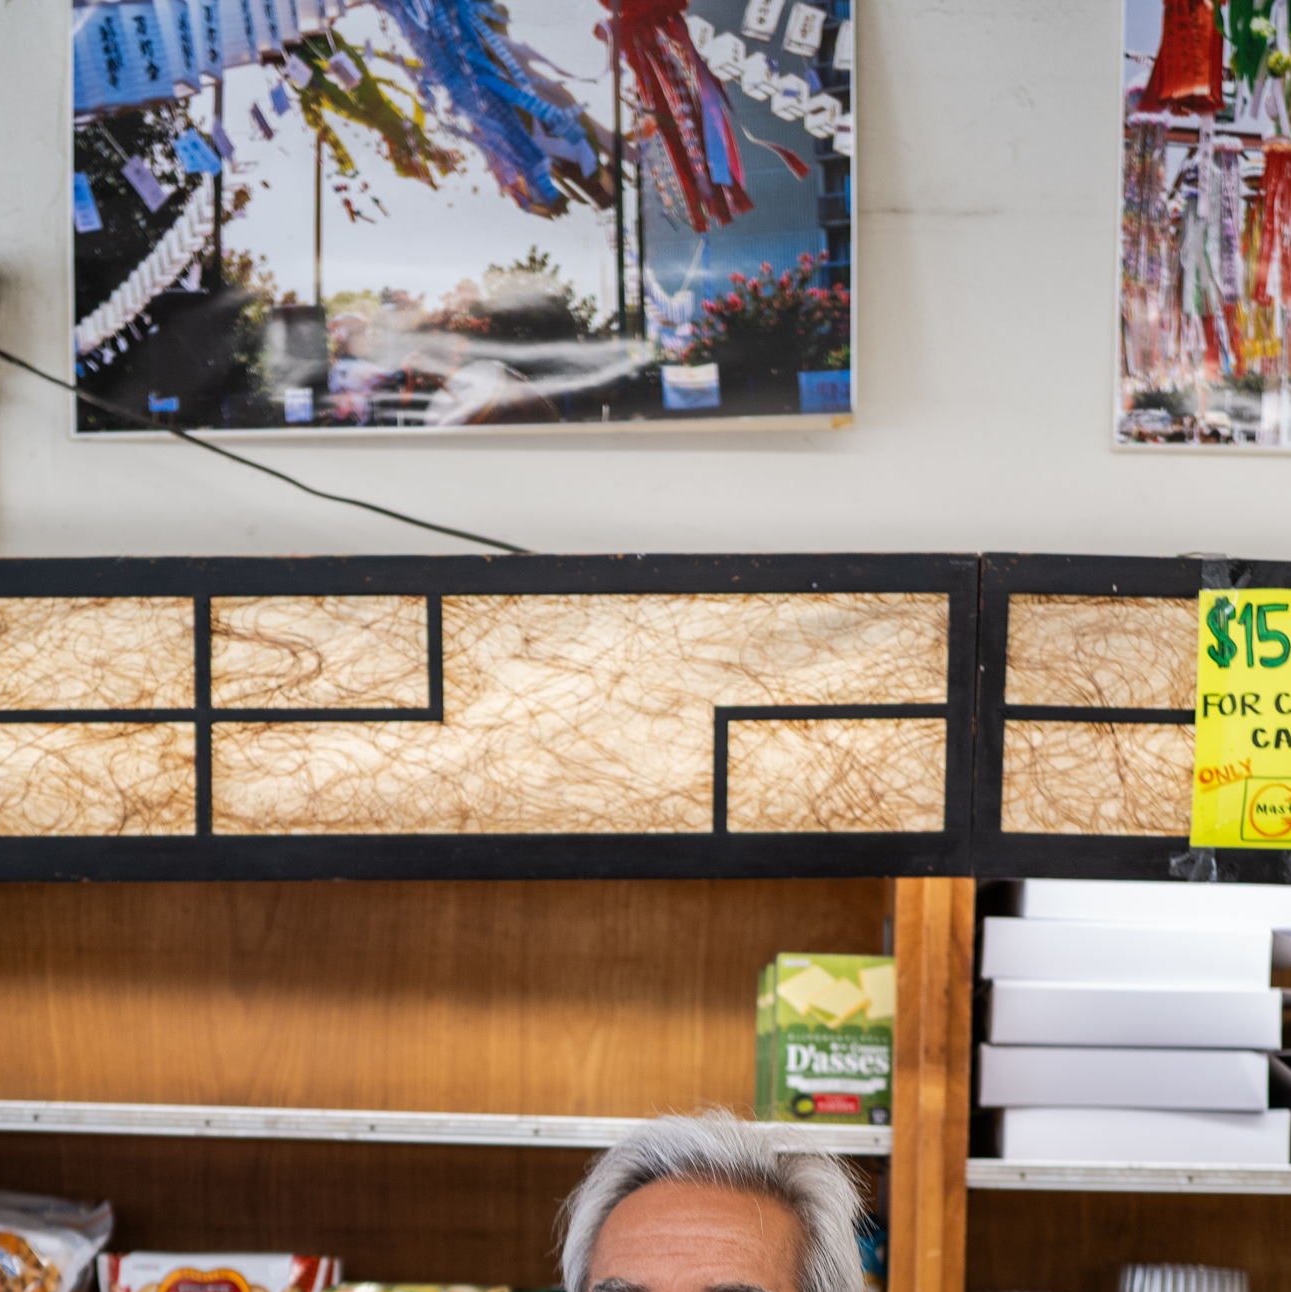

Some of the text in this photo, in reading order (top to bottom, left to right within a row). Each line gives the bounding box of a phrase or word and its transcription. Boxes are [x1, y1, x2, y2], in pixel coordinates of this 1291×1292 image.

[1207, 596, 1291, 668] $15
[1202, 692, 1263, 717] FOR
[1198, 758, 1254, 787] ONLY
